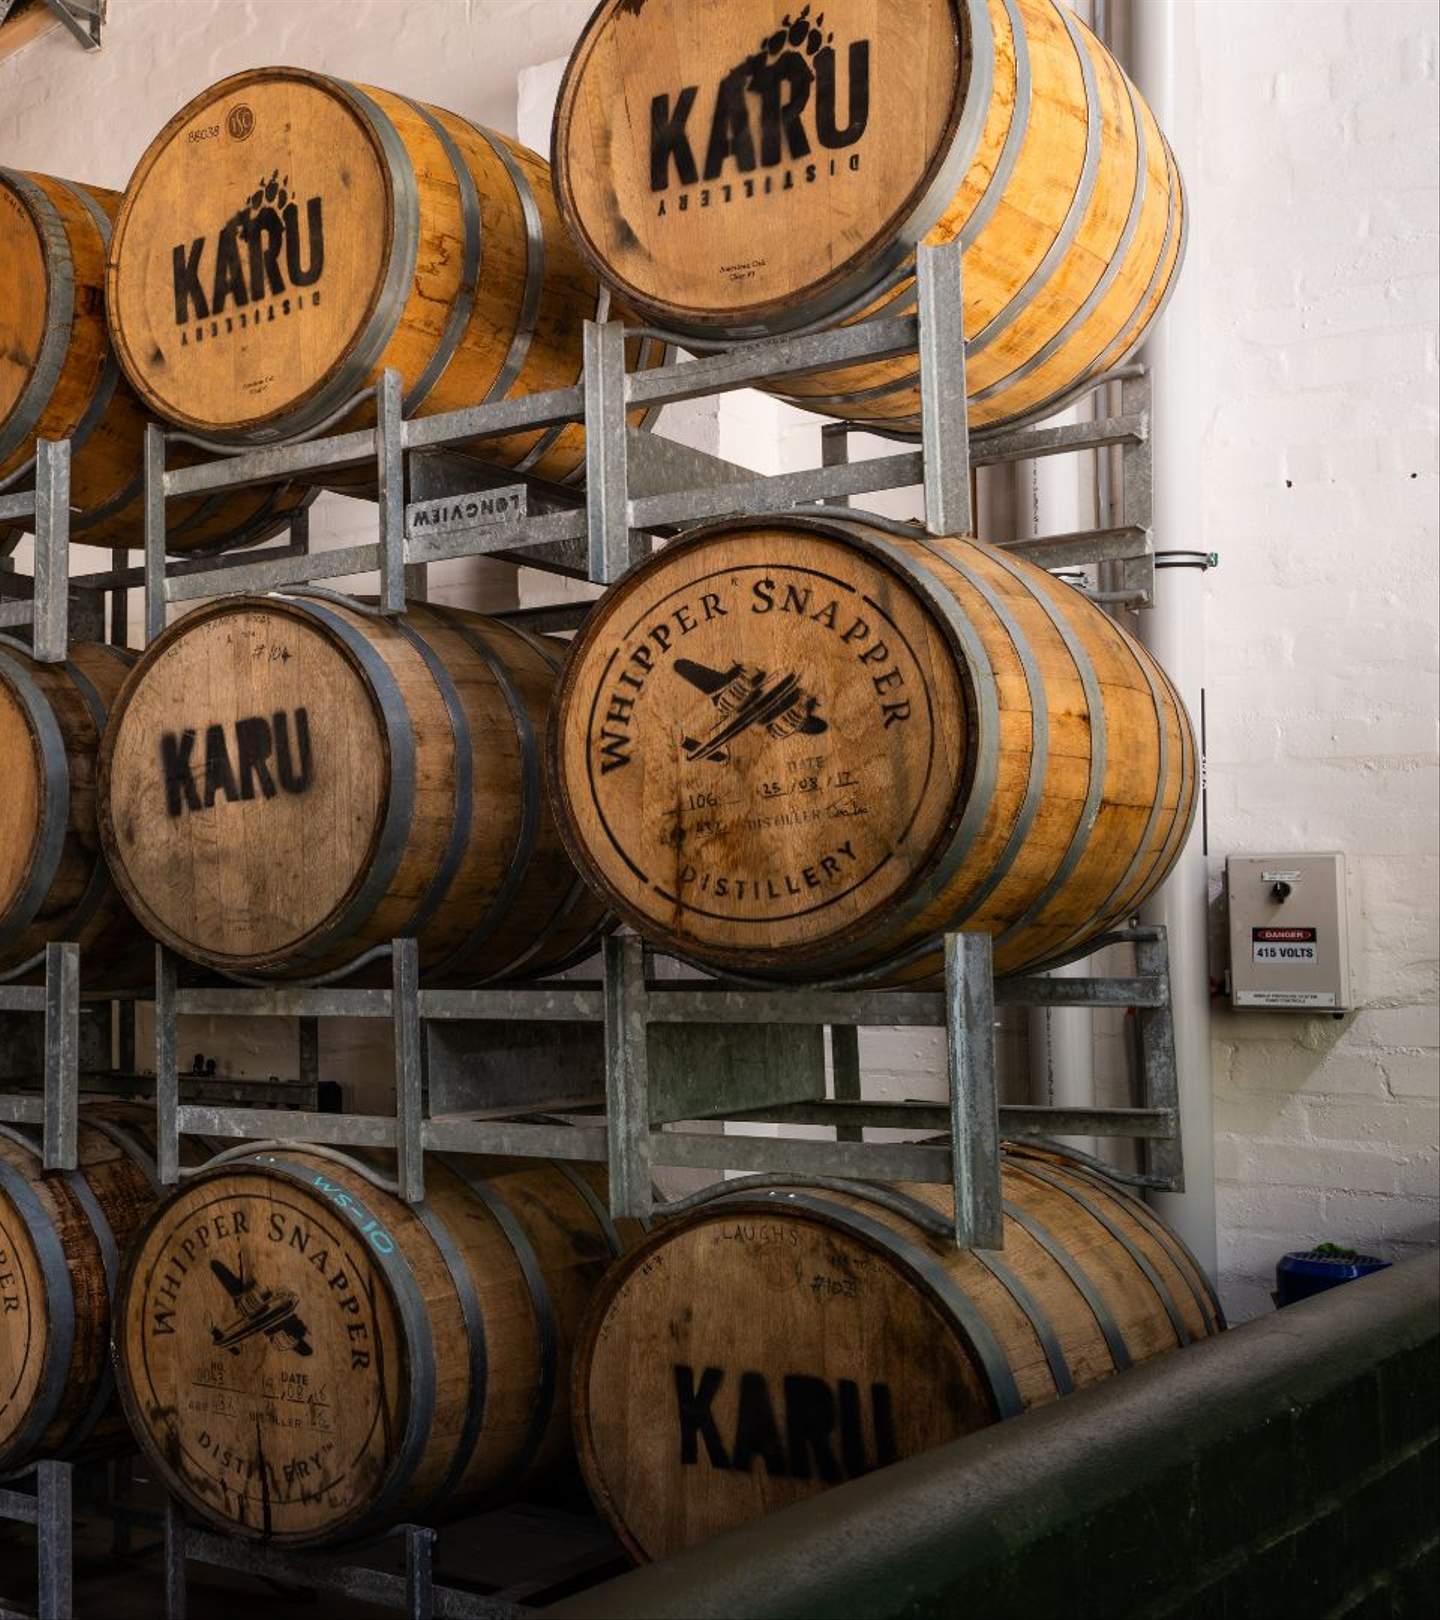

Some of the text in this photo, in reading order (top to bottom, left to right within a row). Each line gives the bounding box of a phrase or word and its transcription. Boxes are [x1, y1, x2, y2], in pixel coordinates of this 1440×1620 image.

[650, 38, 870, 192] KARU
[657, 154, 860, 216] DISTILLERY
[172, 196, 326, 325] KARU
[601, 577, 911, 775] WHIPPER SNAPPER
[162, 706, 311, 818] KARU
[680, 840, 858, 900] DISTILLERY
[1257, 948, 1313, 958] 415 VOLTS
[313, 1176, 394, 1254] WS-10
[153, 1211, 371, 1371] WHIPPER SNAPPER
[280, 1371, 309, 1386] DATE
[673, 1363, 898, 1482] KARU
